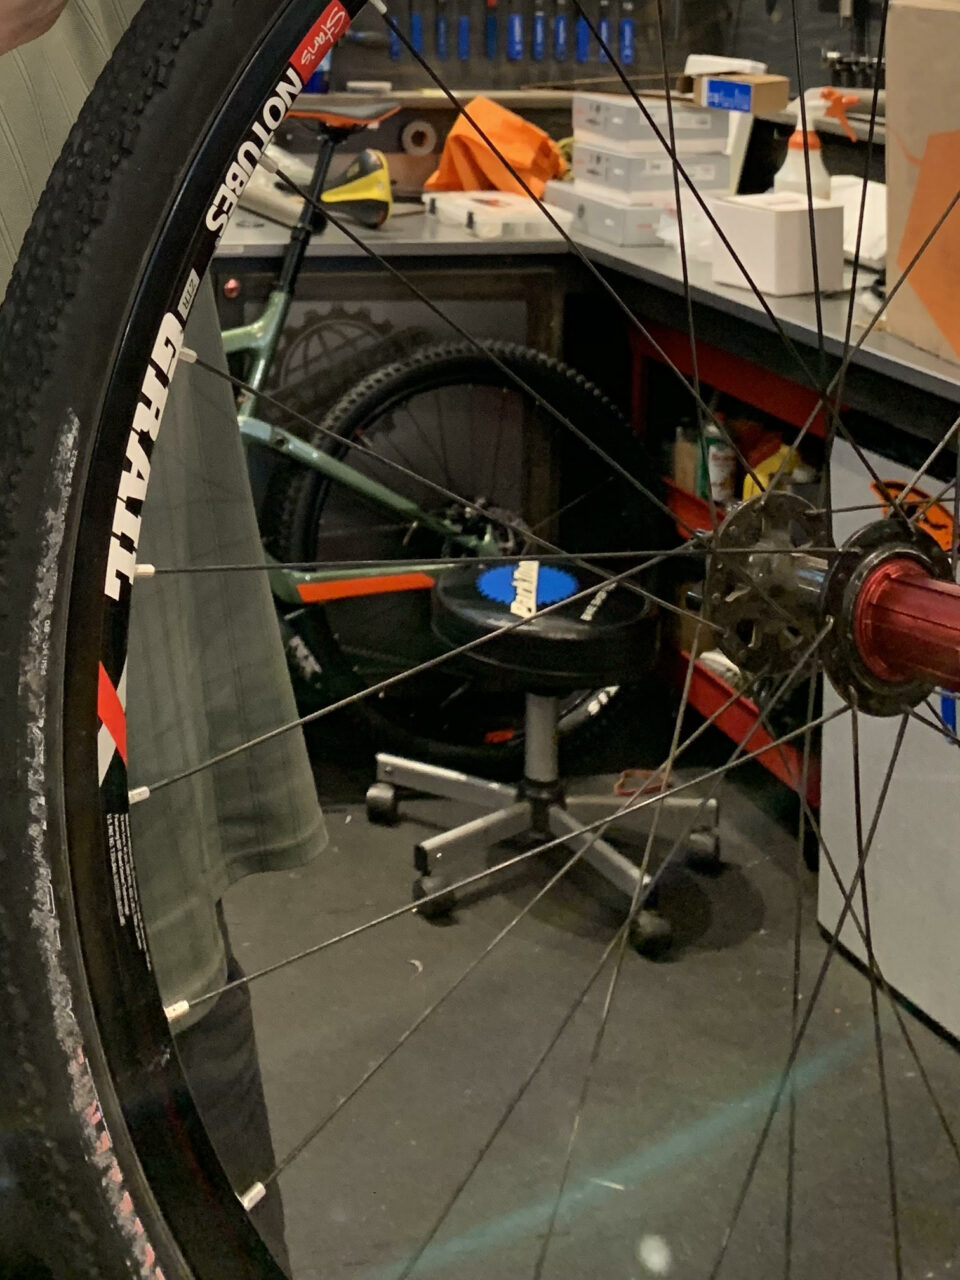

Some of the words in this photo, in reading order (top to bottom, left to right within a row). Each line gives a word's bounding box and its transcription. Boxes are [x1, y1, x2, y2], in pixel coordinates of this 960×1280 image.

[301, 7, 345, 65] Stan's
[206, 67, 303, 239] NOTUBES
[104, 312, 184, 601] GRAIL
